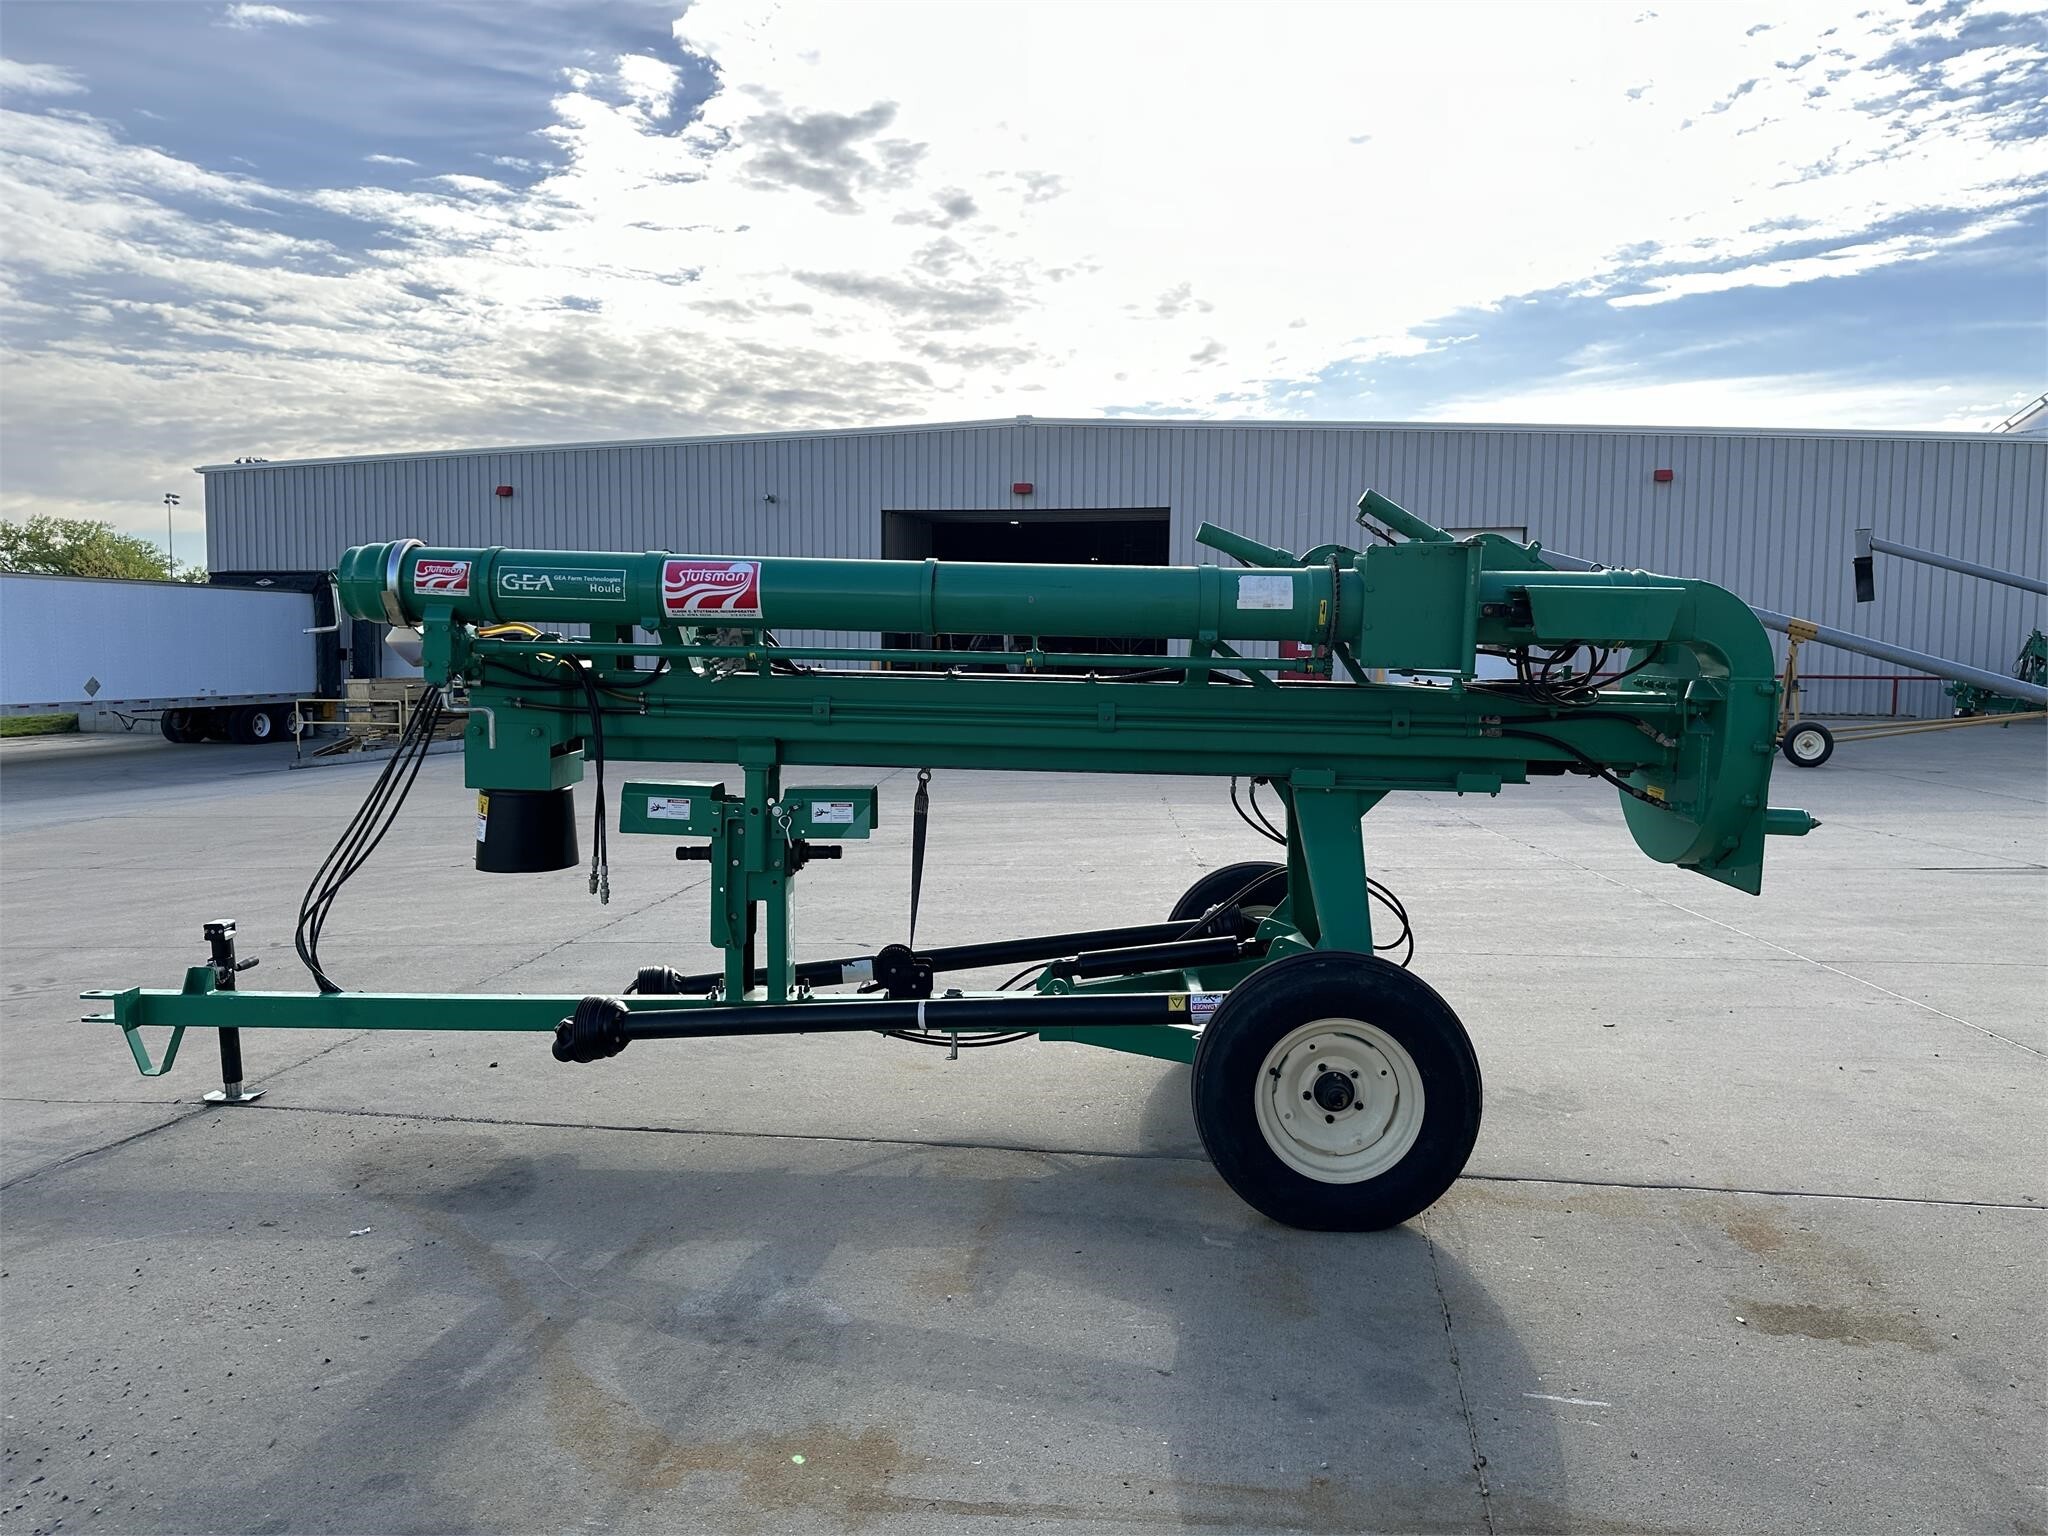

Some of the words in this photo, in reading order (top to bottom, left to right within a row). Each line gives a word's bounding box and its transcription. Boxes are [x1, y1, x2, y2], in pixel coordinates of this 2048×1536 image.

[420, 565, 462, 576] Stutsman
[501, 573, 554, 591] GEA
[584, 575, 622, 583] Technologies
[673, 569, 746, 587] Stutsman
[589, 583, 621, 594] Houle
